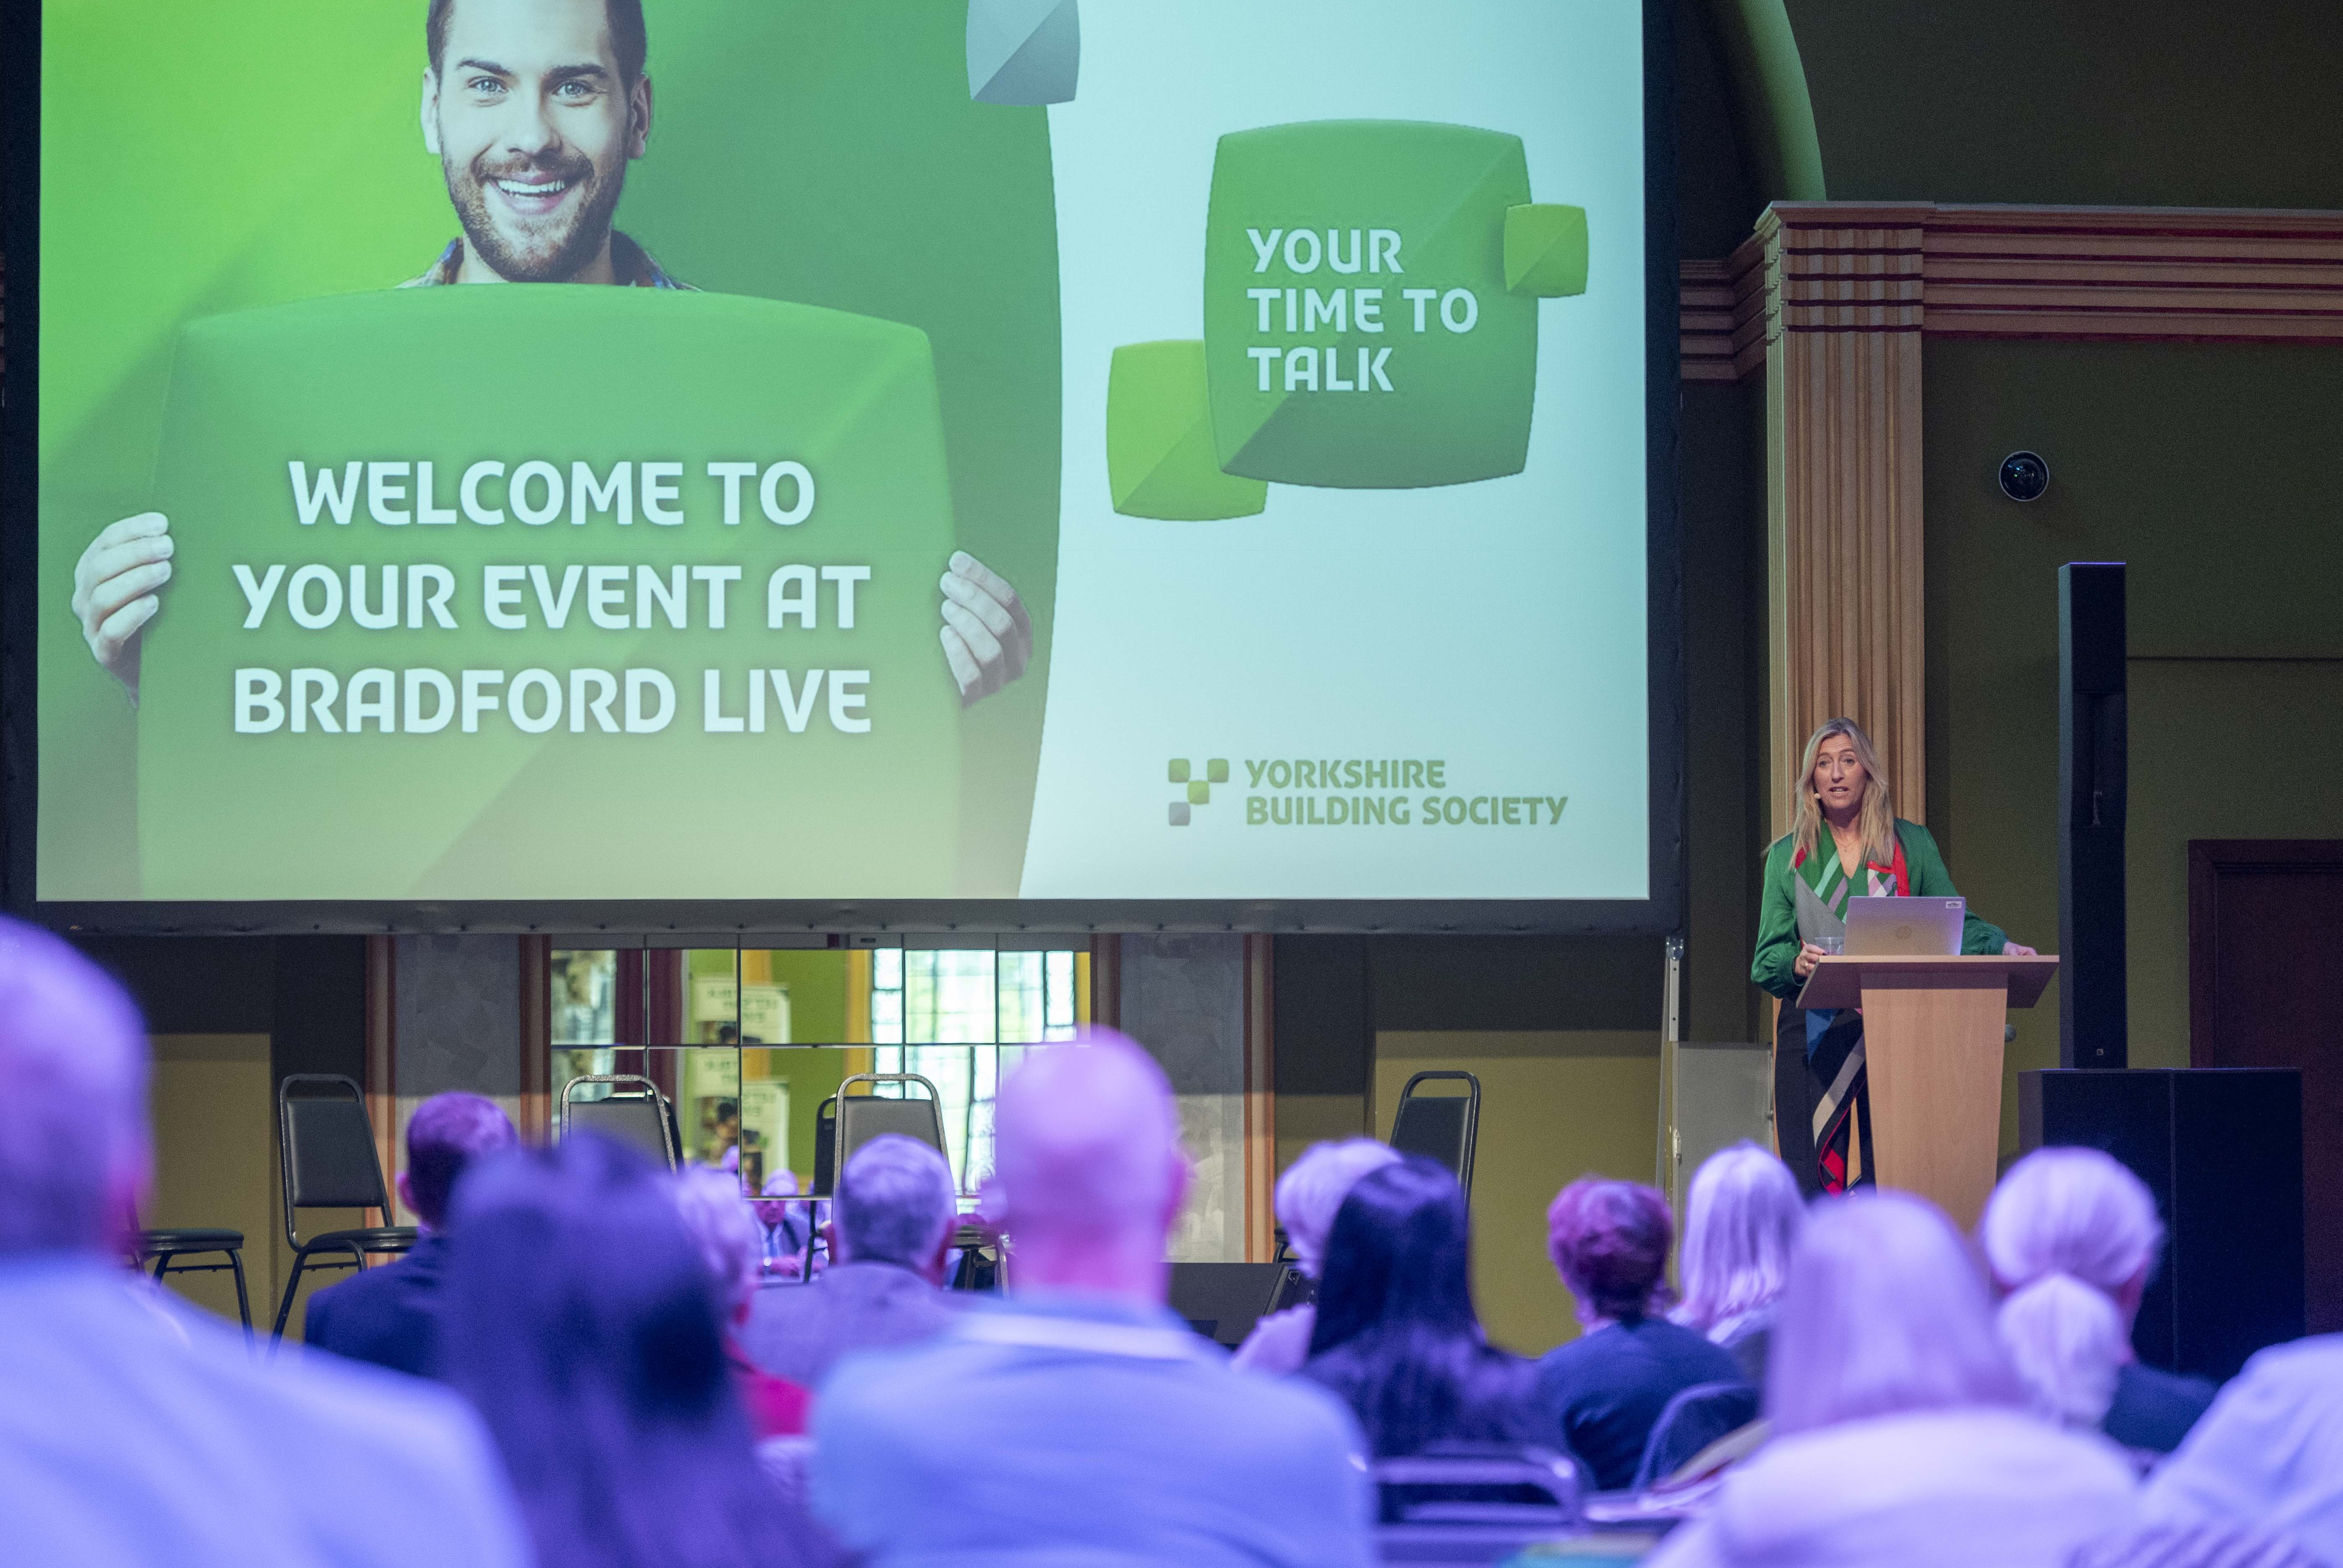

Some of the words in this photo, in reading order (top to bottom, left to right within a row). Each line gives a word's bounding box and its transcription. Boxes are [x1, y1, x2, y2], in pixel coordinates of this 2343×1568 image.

[1247, 229, 1403, 273] YOUR
[1248, 289, 1383, 332] TIME
[1404, 289, 1478, 332] TO
[1248, 347, 1393, 391] TALK
[289, 461, 683, 525] WELCOME
[708, 461, 814, 525] TO
[233, 564, 458, 628] YOUR
[485, 565, 741, 629] EVENT
[769, 565, 870, 628] AT
[236, 669, 675, 733] BRADFORD
[705, 669, 871, 733] LIVE
[1245, 760, 1446, 789] YORKSHIRE
[1247, 796, 1410, 825] BUILDING
[1422, 796, 1568, 825] SOCIETY
